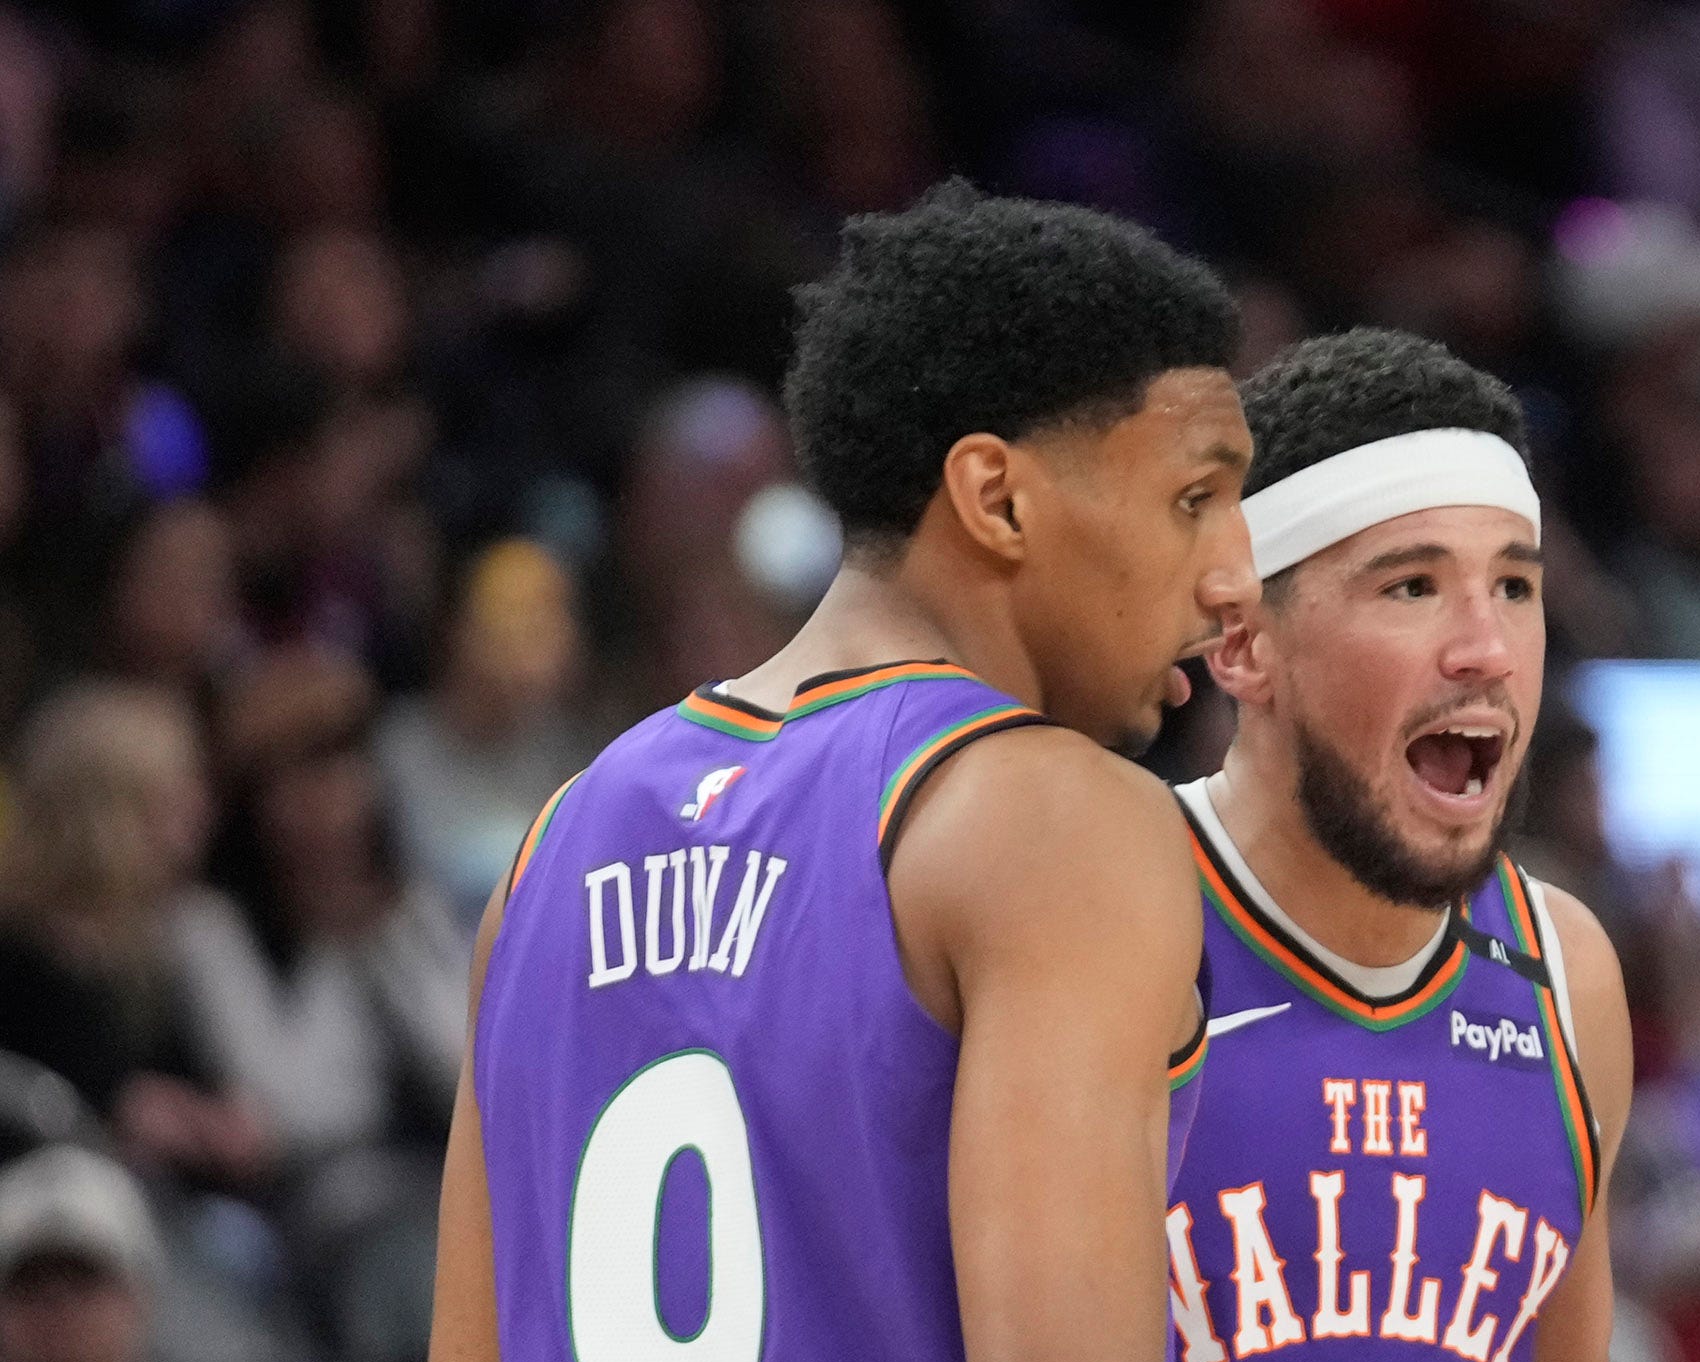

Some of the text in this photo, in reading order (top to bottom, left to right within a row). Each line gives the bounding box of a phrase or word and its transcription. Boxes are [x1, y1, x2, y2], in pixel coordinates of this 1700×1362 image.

[584, 845, 788, 989] DUNN
[1488, 938, 1511, 965] AL
[1451, 1010, 1544, 1061] PayPal
[1322, 1078, 1428, 1156] THE
